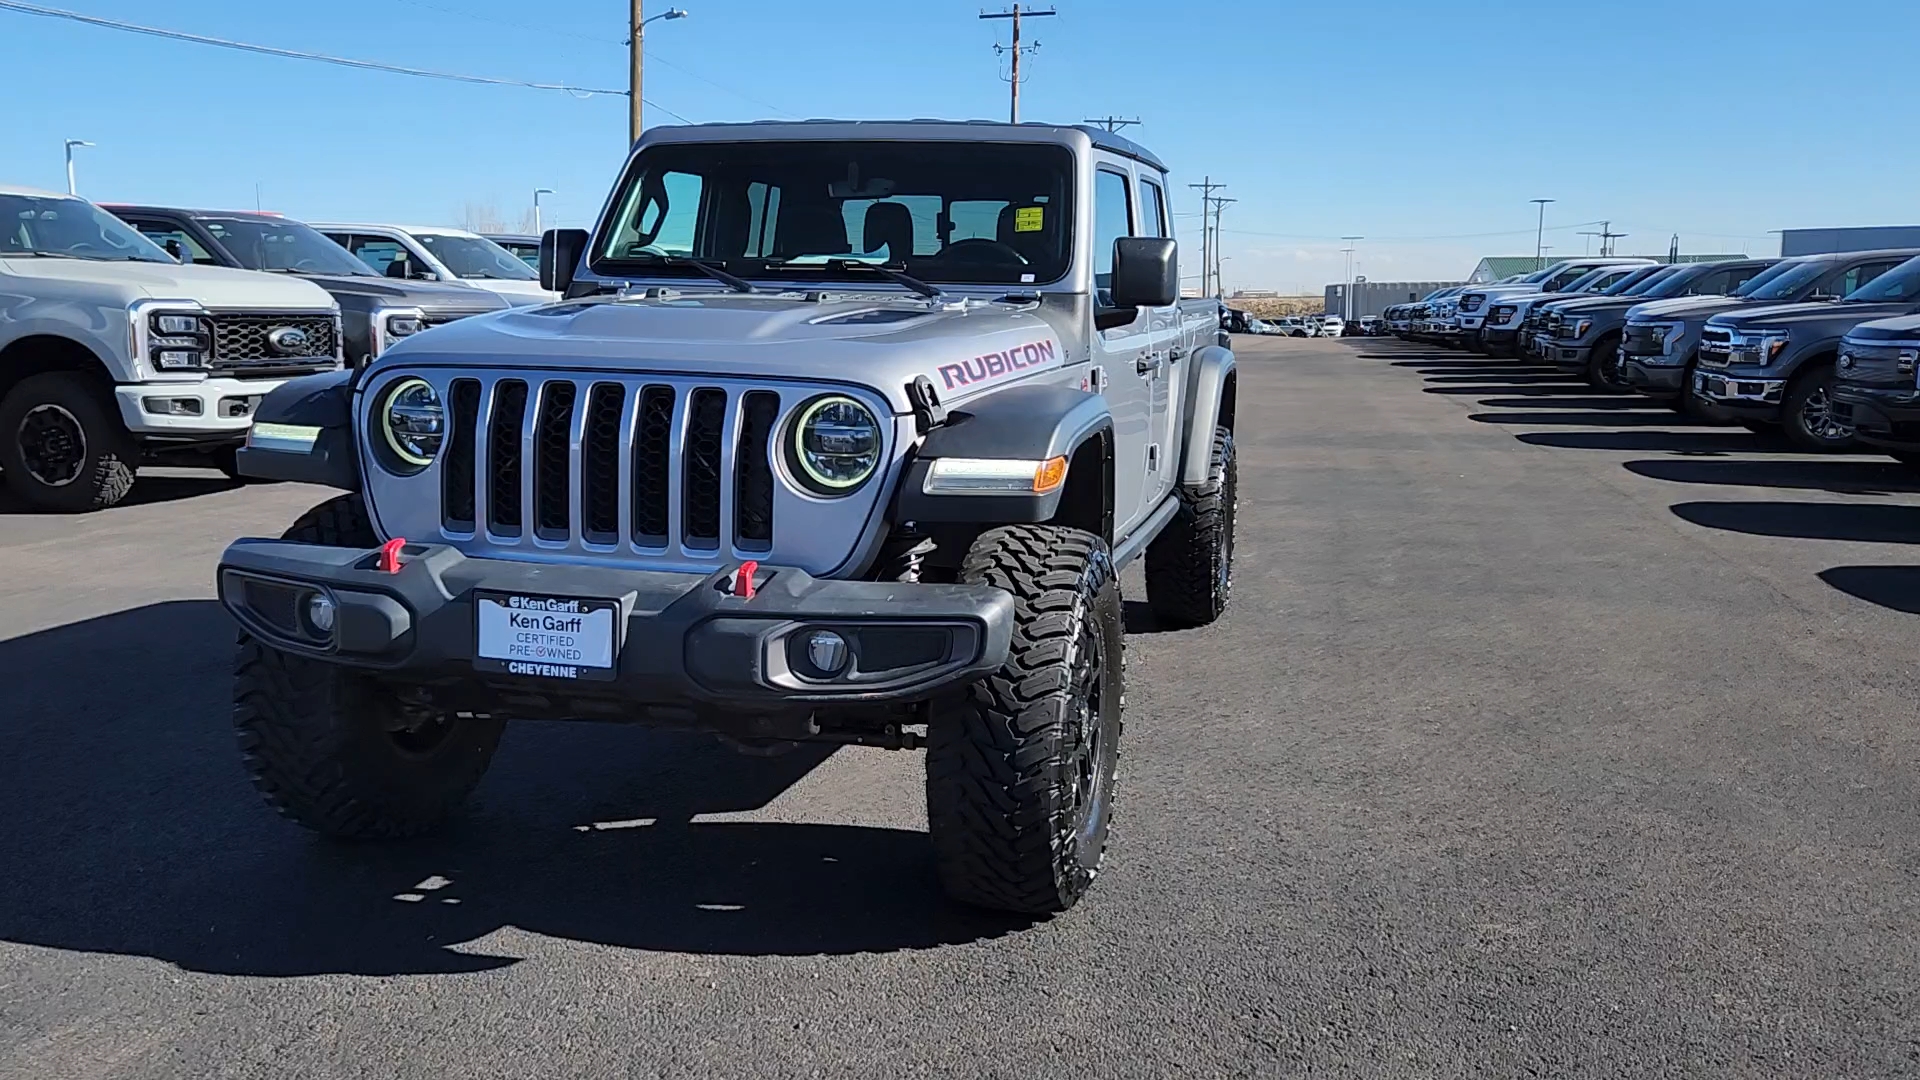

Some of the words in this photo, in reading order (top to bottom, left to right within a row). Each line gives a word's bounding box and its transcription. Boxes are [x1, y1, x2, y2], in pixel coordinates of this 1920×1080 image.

[937, 340, 1056, 390] RUBICON
[520, 597, 546, 611] Ken
[546, 599, 579, 613] Garff
[510, 612, 540, 629] Ken
[543, 616, 581, 633] Garff
[516, 632, 574, 647] CERTIFIED
[508, 662, 577, 679] CHEYENNE
